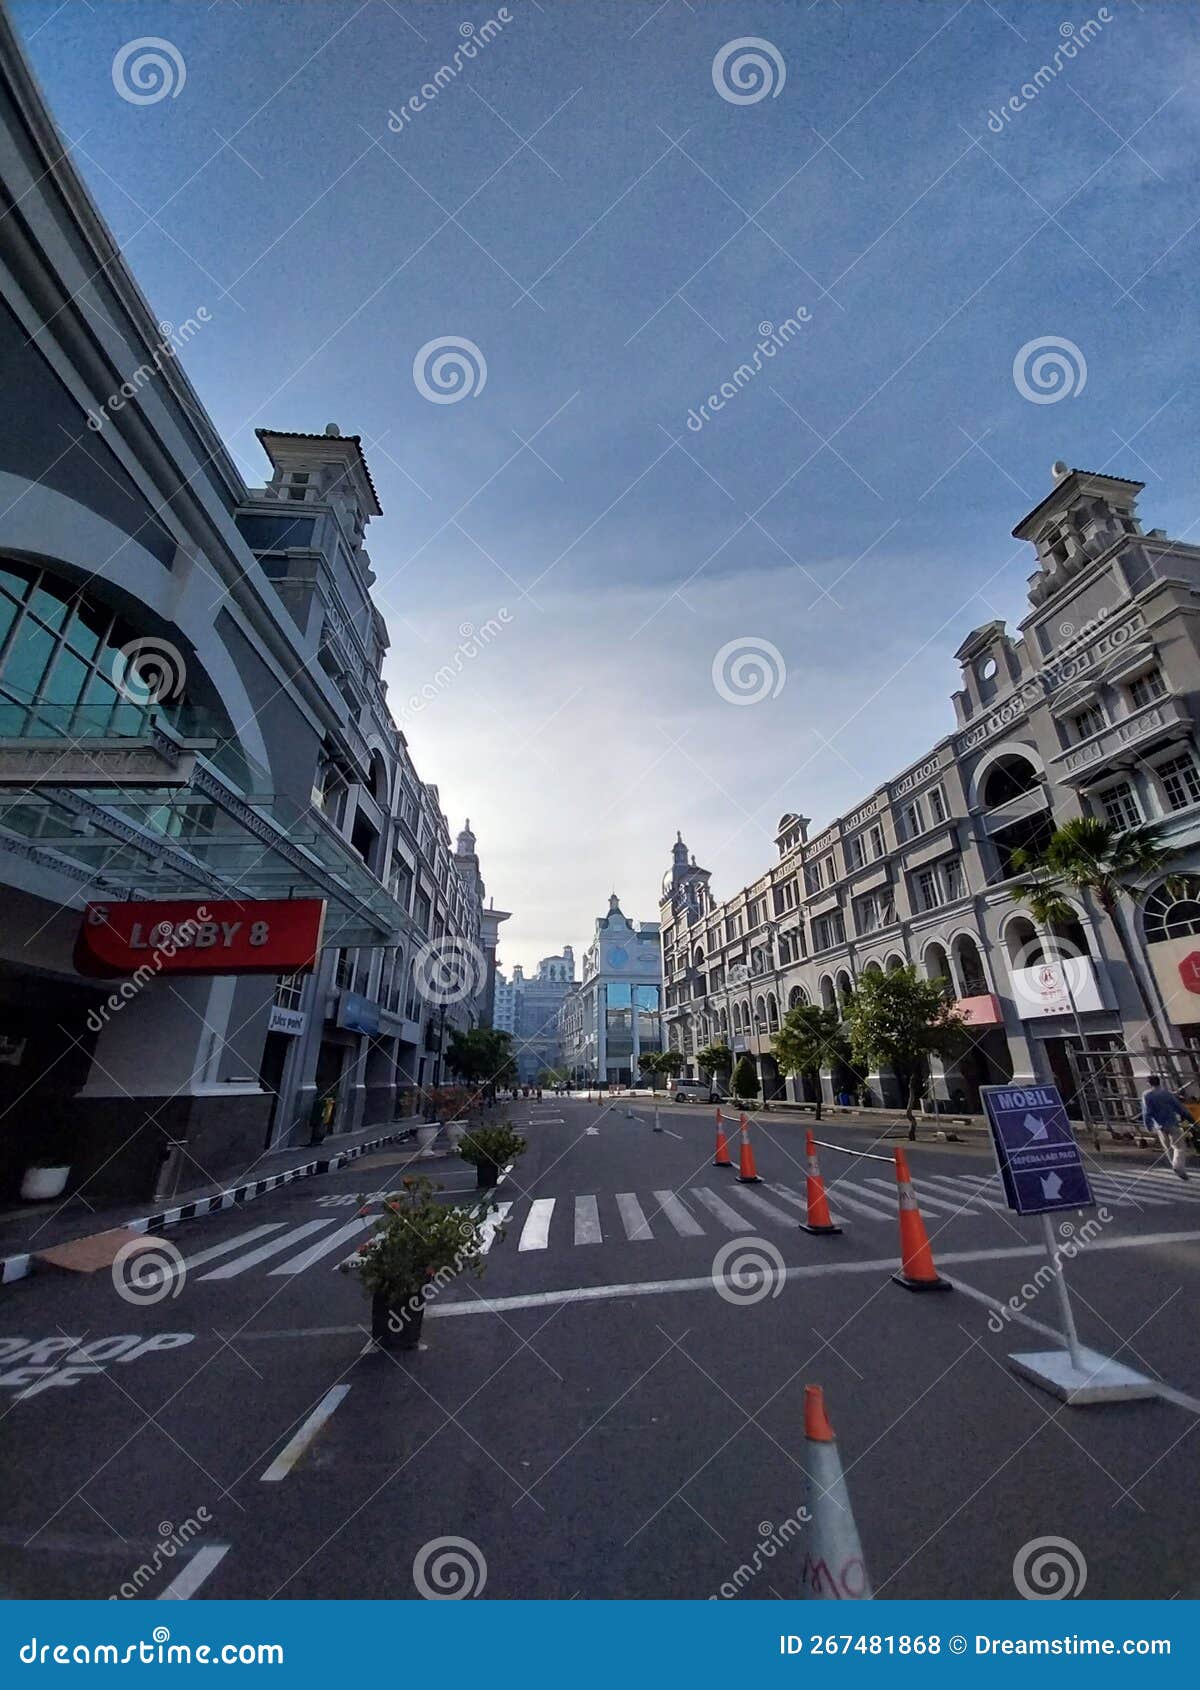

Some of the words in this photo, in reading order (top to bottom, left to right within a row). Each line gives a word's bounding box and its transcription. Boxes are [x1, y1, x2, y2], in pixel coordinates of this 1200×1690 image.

[128, 921, 242, 948] LOBBY
[249, 920, 269, 946] 8
[997, 1090, 1053, 1109] MOBIL
